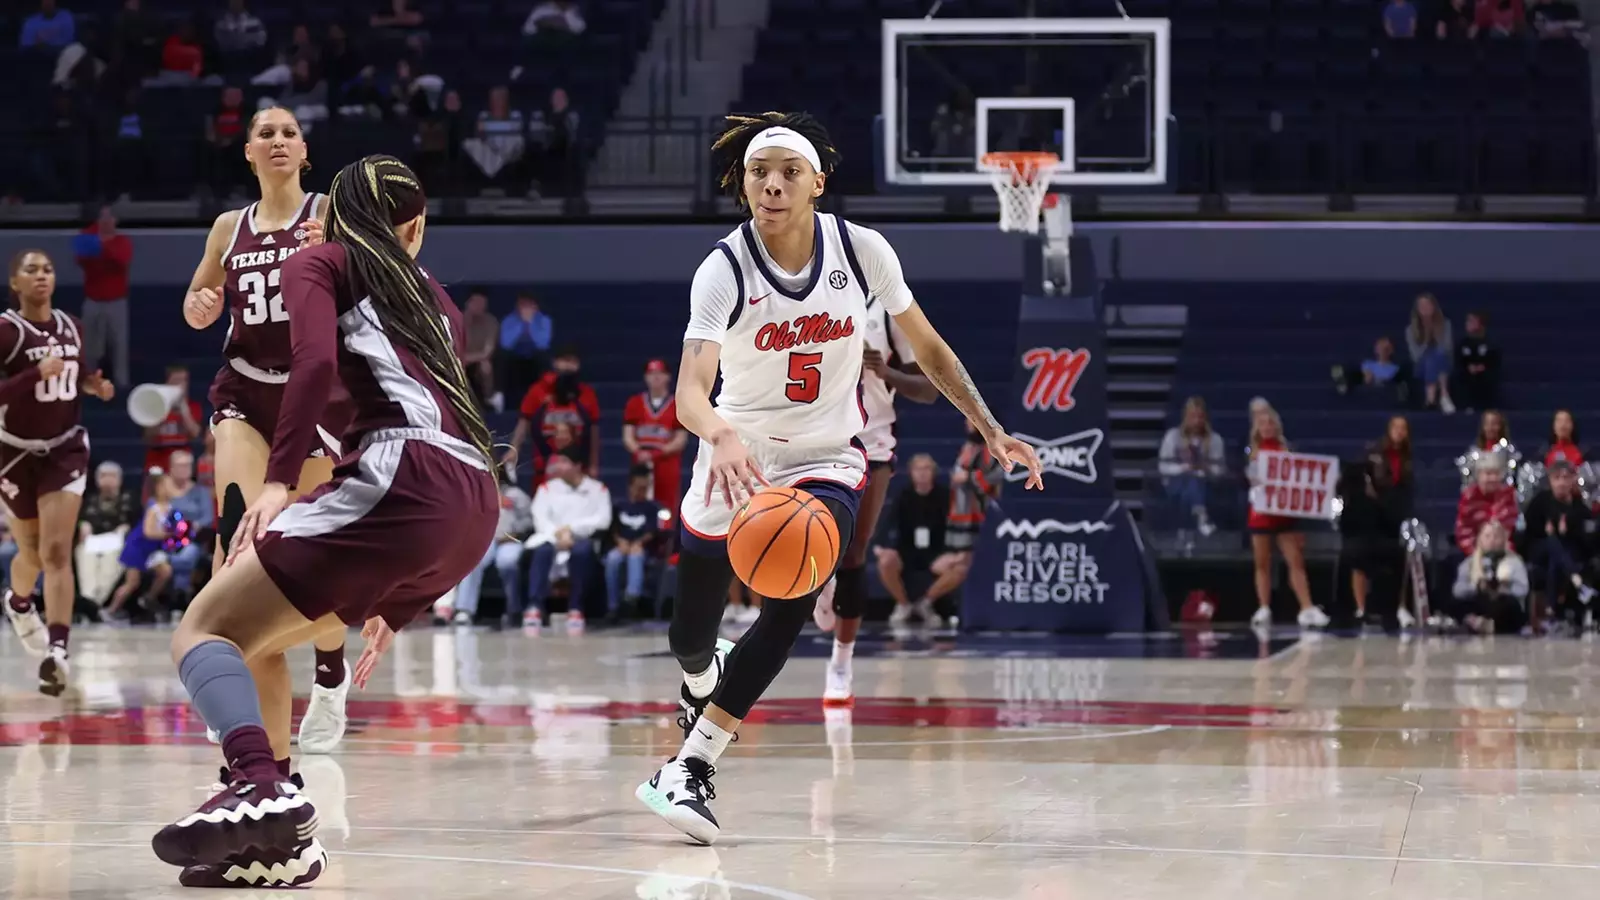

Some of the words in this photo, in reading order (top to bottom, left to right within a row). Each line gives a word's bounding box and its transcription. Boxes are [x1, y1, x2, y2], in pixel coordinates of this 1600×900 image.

[231, 249, 275, 270] TEXAS
[278, 246, 300, 262] A&
[829, 270, 848, 290] SEC
[238, 268, 290, 325] 32
[755, 320, 796, 351] Ole
[794, 311, 855, 348] Miss
[784, 351, 824, 405] 5
[1022, 347, 1091, 411] M
[1035, 445, 1089, 467] ONIC
[1267, 456, 1331, 486] HOTTY
[1264, 485, 1327, 514] TODDY
[1007, 541, 1095, 561] PEARL
[1003, 559, 1099, 583] RIVER
[994, 581, 1110, 604] RESORT
